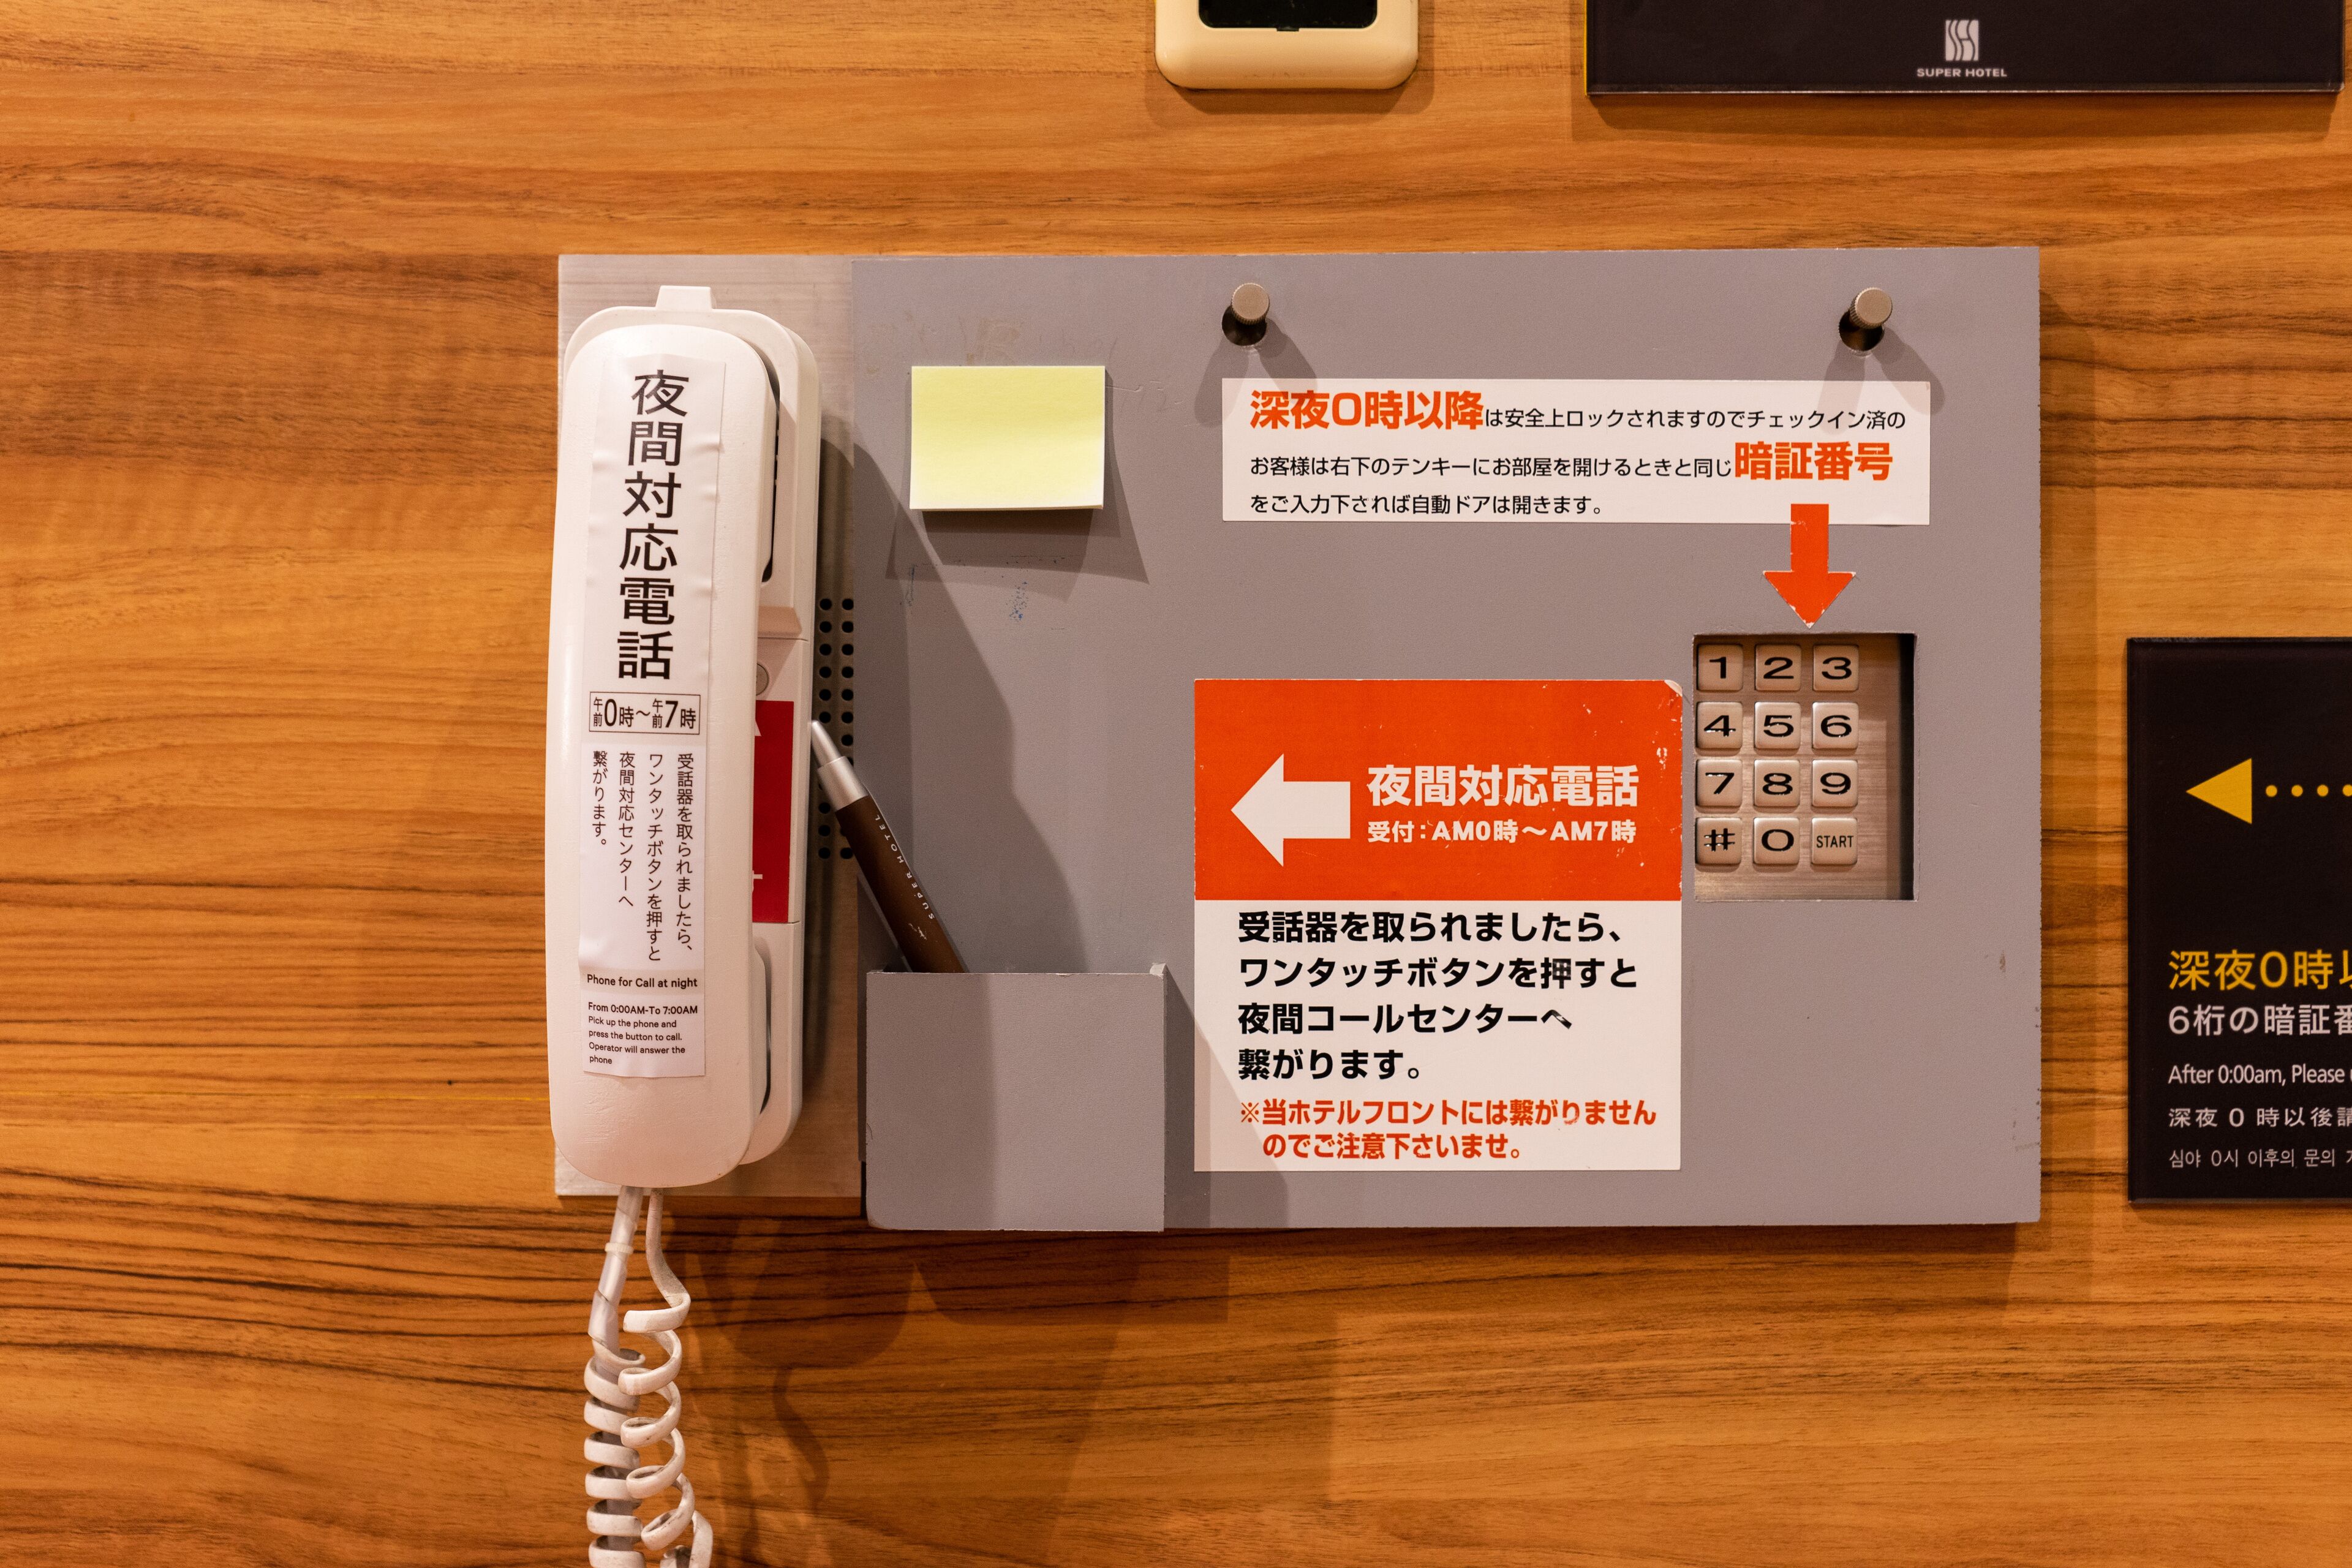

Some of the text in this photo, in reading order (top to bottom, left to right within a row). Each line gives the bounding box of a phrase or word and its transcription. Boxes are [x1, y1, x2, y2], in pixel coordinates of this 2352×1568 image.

[1917, 67, 2008, 77] SUPER HOTEL
[1250, 494, 1602, 514] をご入力下されば自動ドアは開きます。
[617, 369, 690, 680] 夜間対応電話
[1709, 656, 1852, 680] 1 2 3
[1703, 715, 1852, 737] 4 5 6
[1367, 764, 1639, 807] 夜間対応電話
[1705, 772, 1851, 795] 7 8 9
[592, 750, 608, 845] 繋がります。
[618, 752, 636, 907] 夜間対応センターへ
[1703, 827, 1854, 852] # 0 START
[646, 753, 664, 961] ワンタッチボタンを押すと
[676, 753, 694, 951] 受話器を取られましたら、
[873, 813, 935, 920] SUPER HOTEL
[1238, 910, 1621, 944] 受話器を取られましたら、
[587, 974, 616, 986] Phone
[619, 977, 633, 987] for
[635, 978, 655, 987] Call
[671, 978, 698, 989] night
[1238, 957, 1638, 990] ワンタッチボタンを押すと
[588, 1002, 698, 1014] From 0:00AM-To 7:00AM
[1237, 1003, 1573, 1036] 夜間コールセンターへ
[589, 1016, 604, 1025] Pick
[633, 1020, 659, 1028] phone
[589, 1042, 622, 1052] Operator
[625, 1032, 652, 1041] button
[589, 1055, 612, 1065] phone
[1238, 1048, 1422, 1080] 繋がります。
[2168, 1063, 2214, 1084] After
[2218, 1065, 2286, 1087] 0:00am,
[2292, 1063, 2345, 1084] Please
[1263, 1133, 1520, 1160] のでご注意下さいませ。
[2169, 1149, 2201, 1168] 심야
[2211, 1149, 2239, 1168] 0시
[2248, 1148, 2295, 1168] 이후의
[2304, 1148, 2335, 1168] 문의
